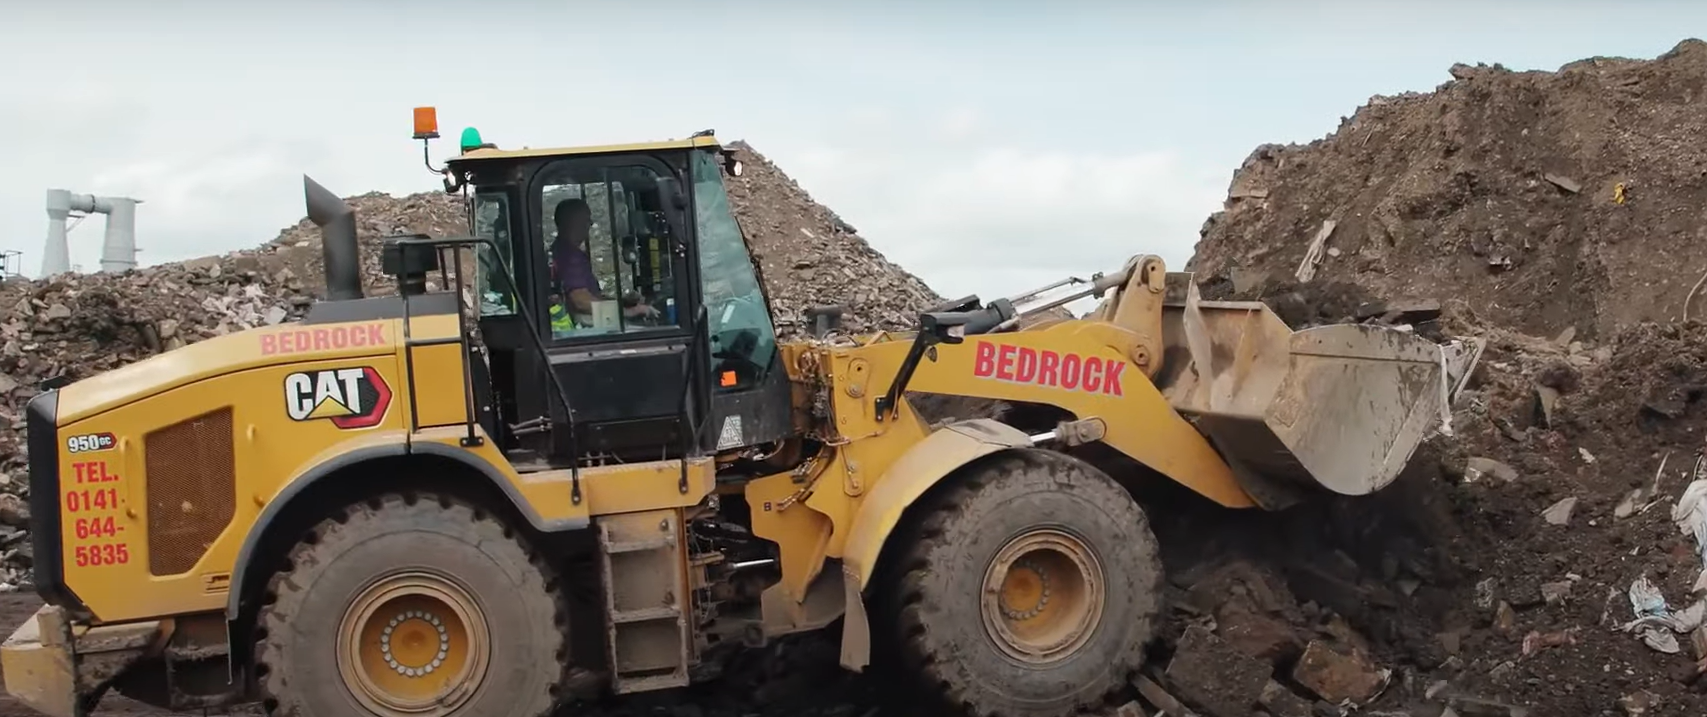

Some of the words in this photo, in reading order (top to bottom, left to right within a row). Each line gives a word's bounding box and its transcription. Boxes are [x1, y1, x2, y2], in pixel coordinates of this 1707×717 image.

[260, 324, 385, 355] BEDROCK
[974, 340, 1126, 396] BEDROCK
[285, 368, 363, 420] CAT
[72, 462, 119, 483] TEL.
[75, 516, 124, 539] 644-
[75, 543, 129, 566] 5835
